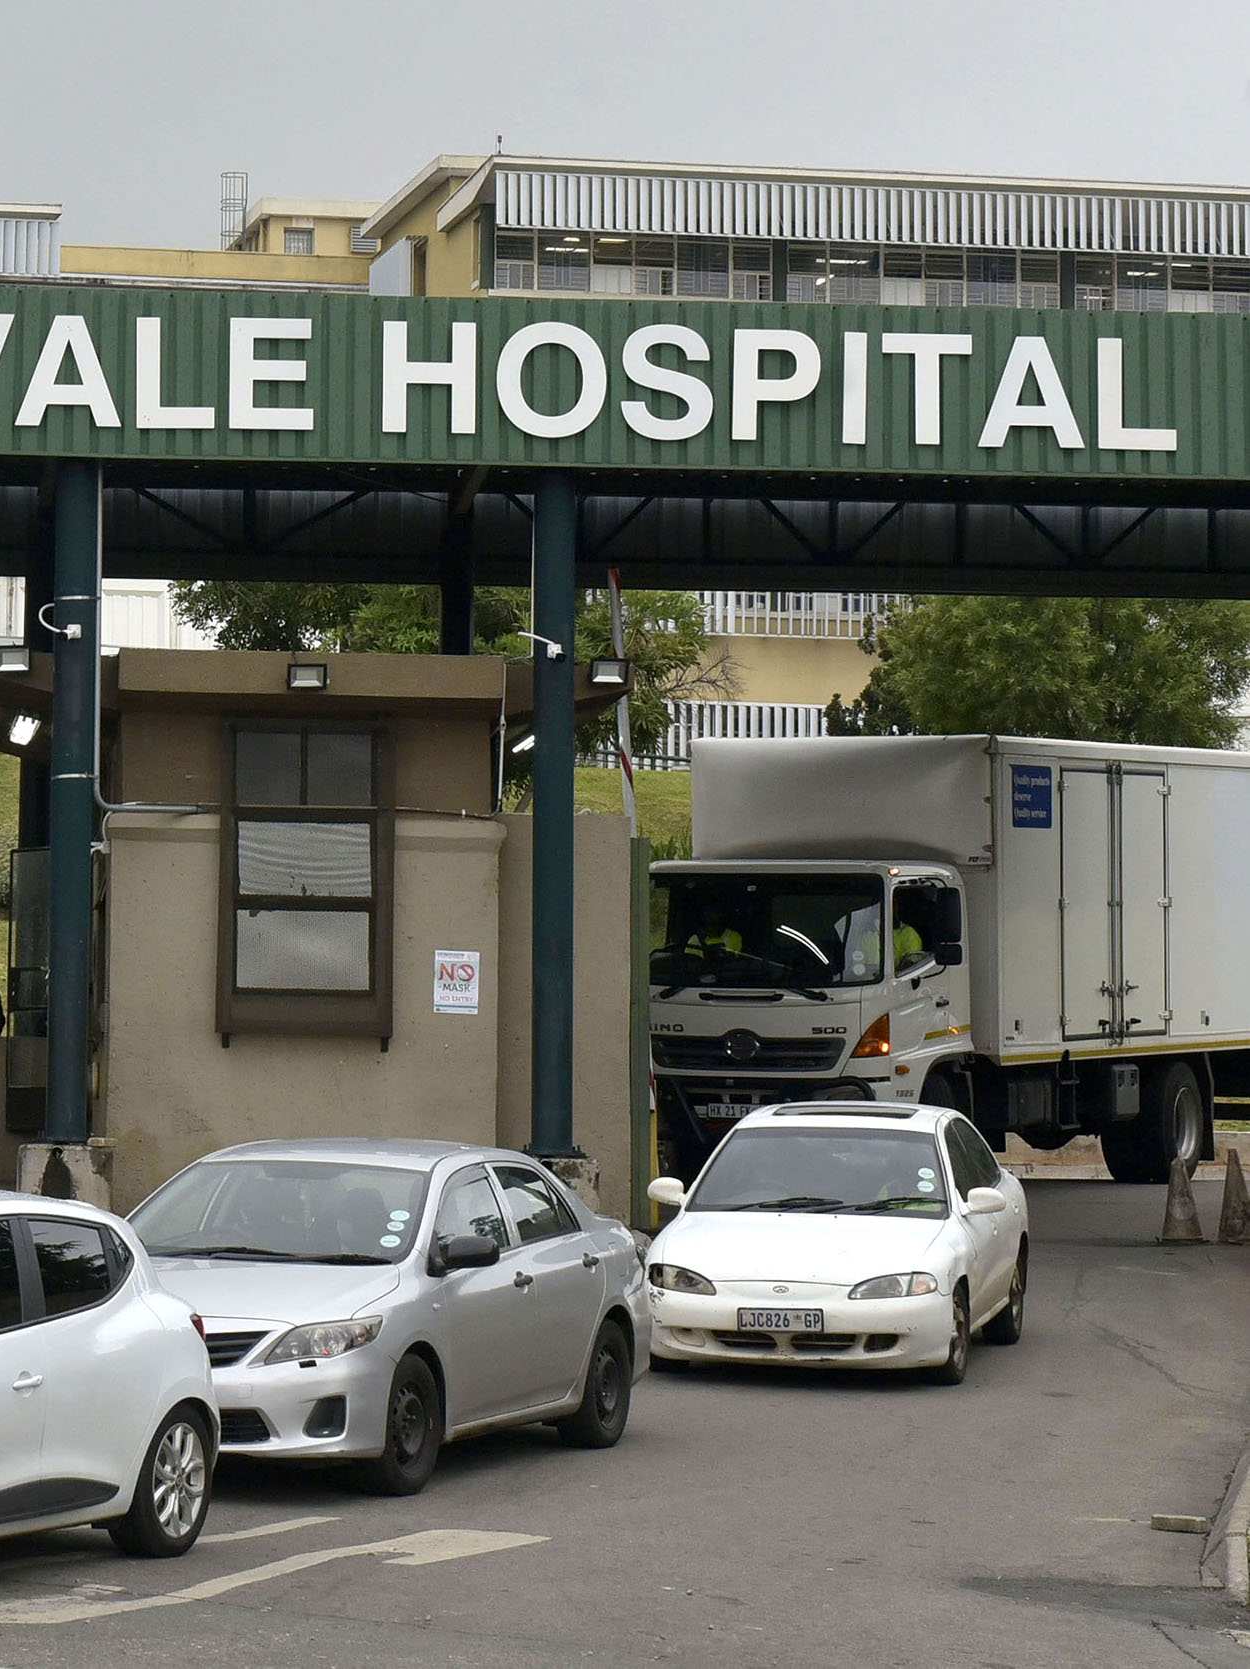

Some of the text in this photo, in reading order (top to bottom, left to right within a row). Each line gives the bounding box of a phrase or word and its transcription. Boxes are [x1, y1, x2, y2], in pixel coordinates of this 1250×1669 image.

[381, 320, 1178, 452] HOSPITAL
[439, 963, 475, 982] NO
[442, 983, 471, 993] MASK
[811, 1026, 847, 1034] 500
[710, 1105, 721, 1116] HX
[725, 1105, 736, 1117] 21
[740, 1312, 820, 1329] LJC826 GP
